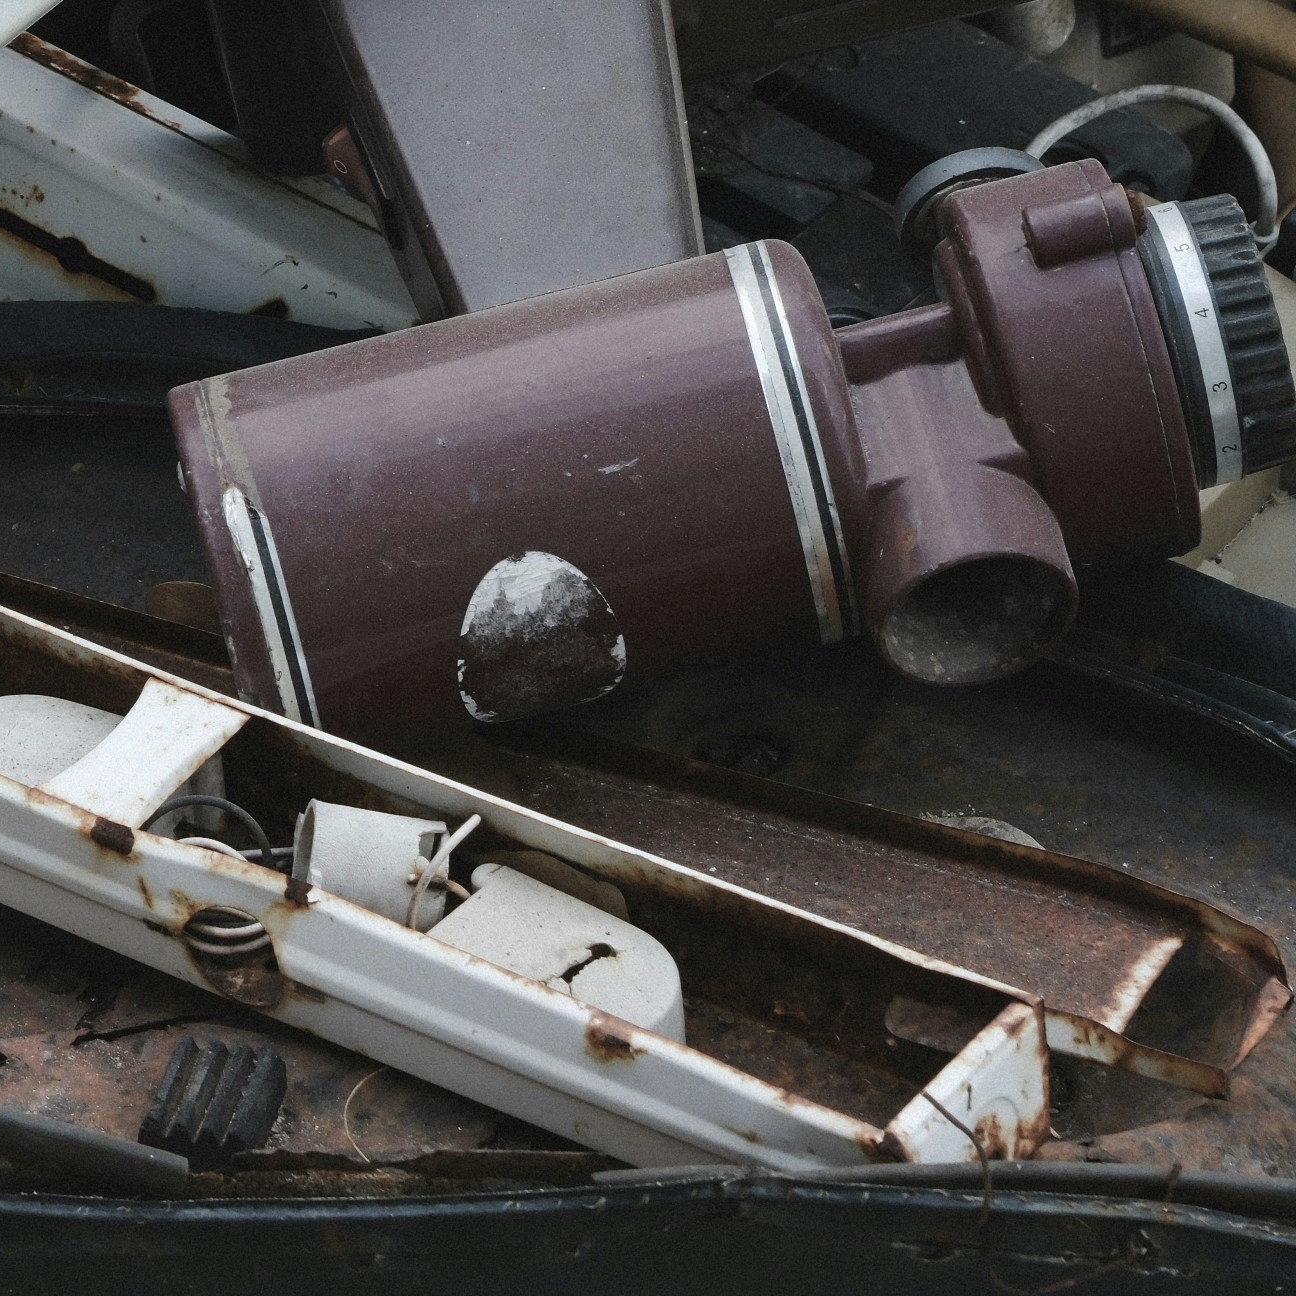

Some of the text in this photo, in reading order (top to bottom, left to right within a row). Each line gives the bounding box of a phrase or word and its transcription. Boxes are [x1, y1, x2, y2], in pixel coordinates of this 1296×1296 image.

[1174, 242, 1190, 253] 5
[1194, 307, 1210, 318] 4
[1212, 381, 1227, 393] 3
[1222, 444, 1237, 454] 2
